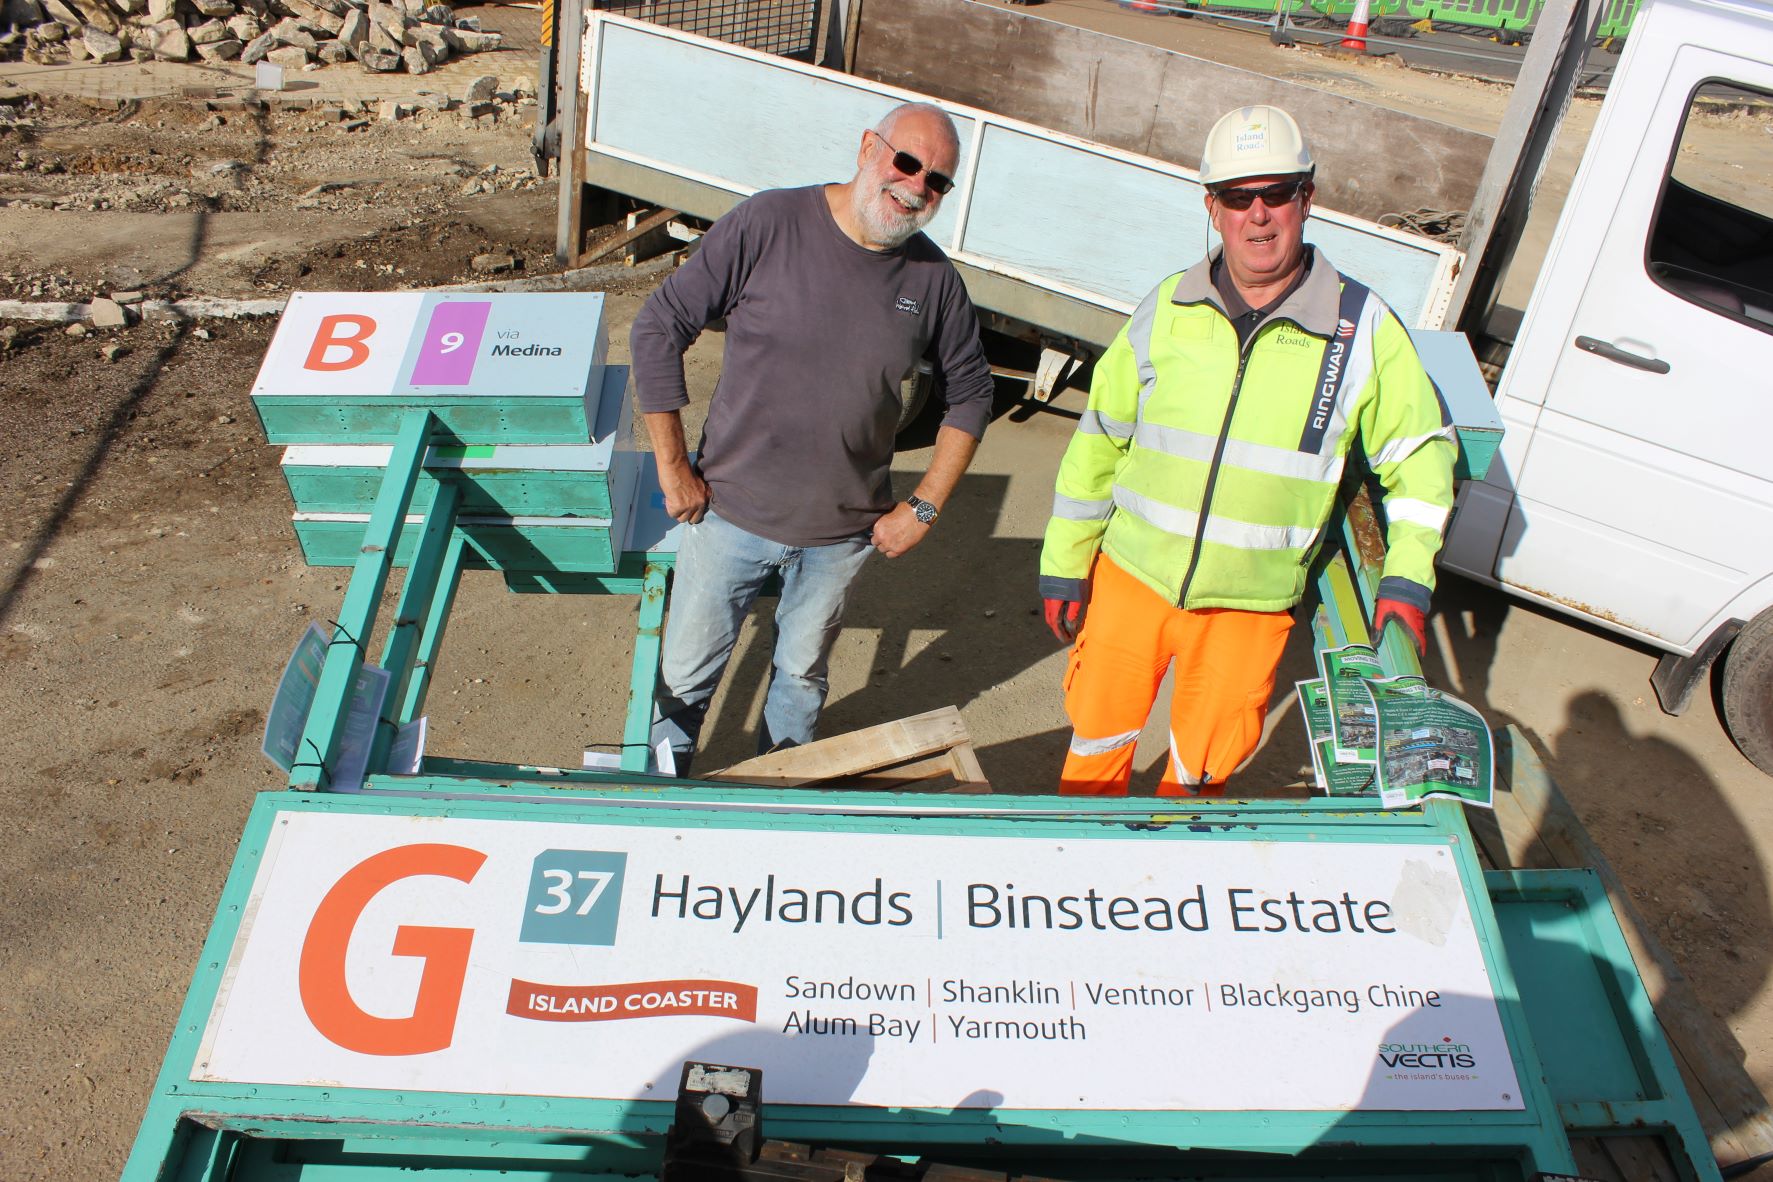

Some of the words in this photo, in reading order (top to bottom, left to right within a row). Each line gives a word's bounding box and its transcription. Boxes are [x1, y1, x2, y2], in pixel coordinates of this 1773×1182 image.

[1236, 131, 1265, 144] Island
[303, 313, 378, 372] B
[440, 331, 465, 354] 9
[496, 328, 521, 340] via
[1276, 334, 1311, 349] Roads
[491, 344, 562, 358] Medina
[1312, 341, 1345, 430] RINGWAY
[534, 869, 615, 916] 37
[651, 873, 913, 934] Haylands
[967, 882, 1210, 932] Binstead
[1227, 887, 1397, 934] Estate
[298, 843, 489, 1057] G
[528, 993, 618, 1014] ISLAND
[624, 991, 738, 1011] COASTER
[785, 975, 916, 1001] Sandown
[942, 978, 1060, 1005] Shanklin
[1085, 983, 1194, 1006] Ventnor
[1220, 982, 1360, 1013] Blackgang
[1367, 984, 1442, 1009] Chine
[782, 1009, 857, 1036] Alum
[868, 1013, 921, 1043] Bay
[948, 1015, 1086, 1040] Yarmouth
[1378, 1043, 1470, 1053] SOUTHERN
[1379, 1053, 1476, 1068] VECTIS
[1410, 1073, 1443, 1081] island's
[1444, 1073, 1470, 1081] buses
